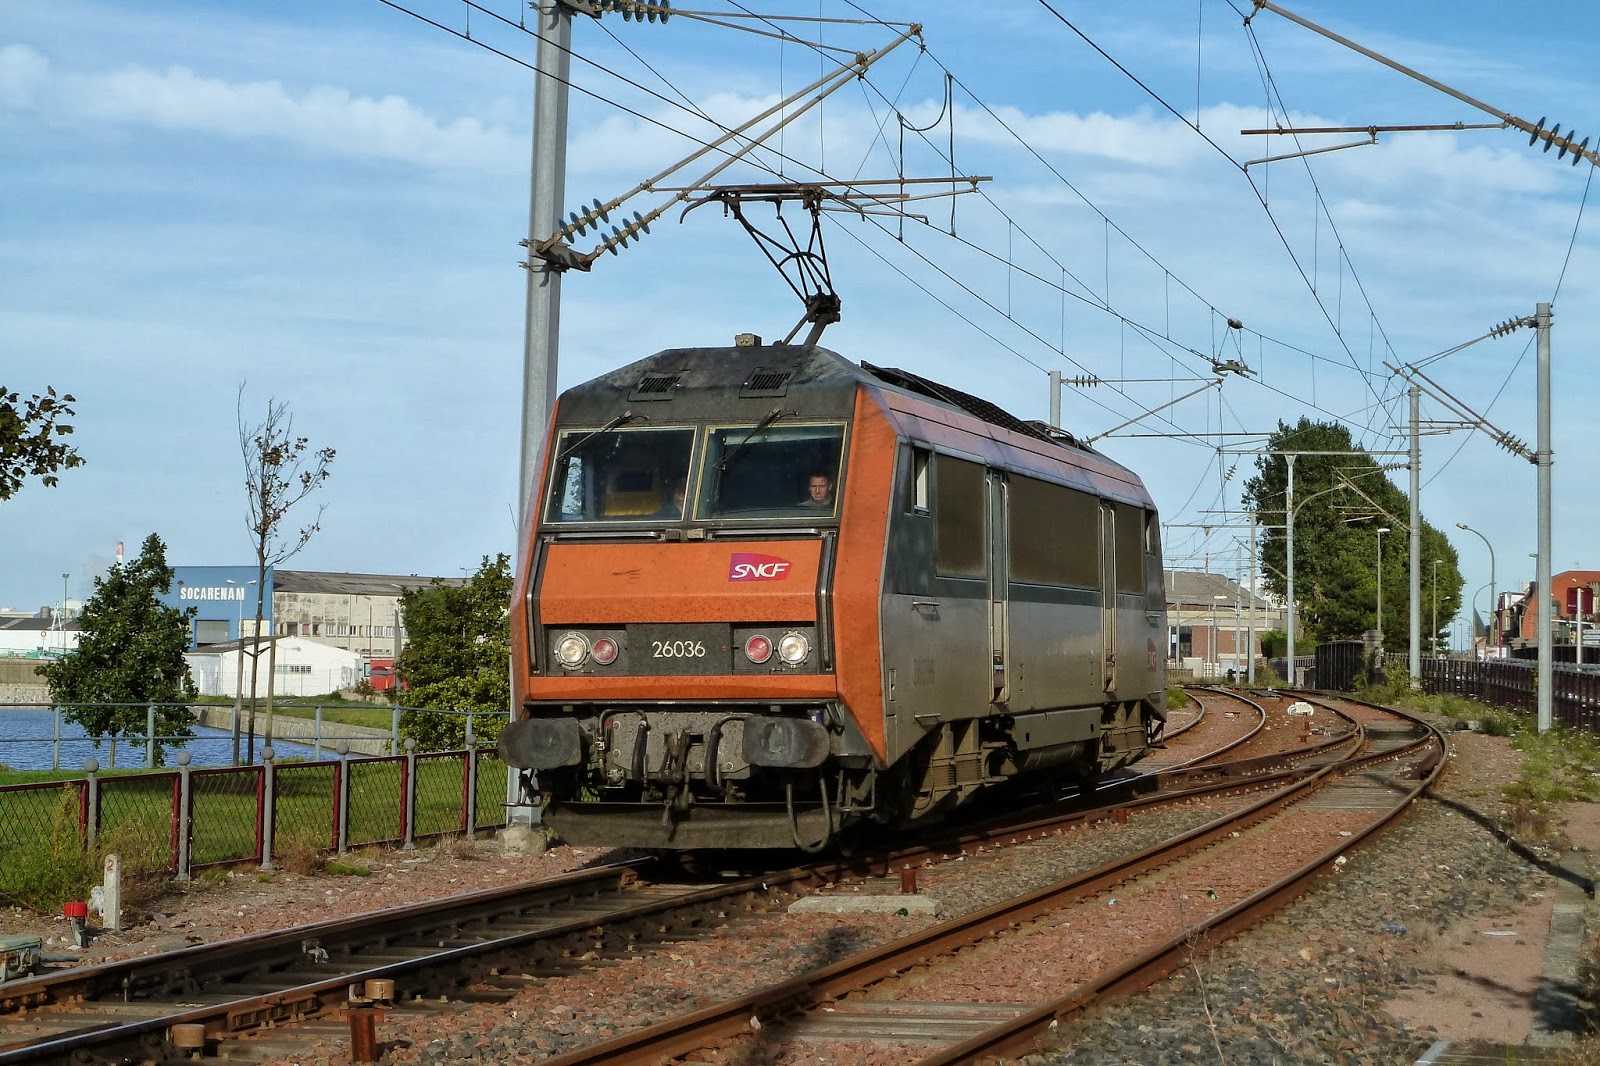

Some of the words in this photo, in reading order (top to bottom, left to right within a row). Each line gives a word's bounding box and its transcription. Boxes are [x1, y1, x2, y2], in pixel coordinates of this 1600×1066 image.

[731, 563, 790, 578] SNCF
[180, 587, 245, 600] SOCARENAM
[652, 641, 706, 657] 26036
[107, 859, 114, 871] 2
